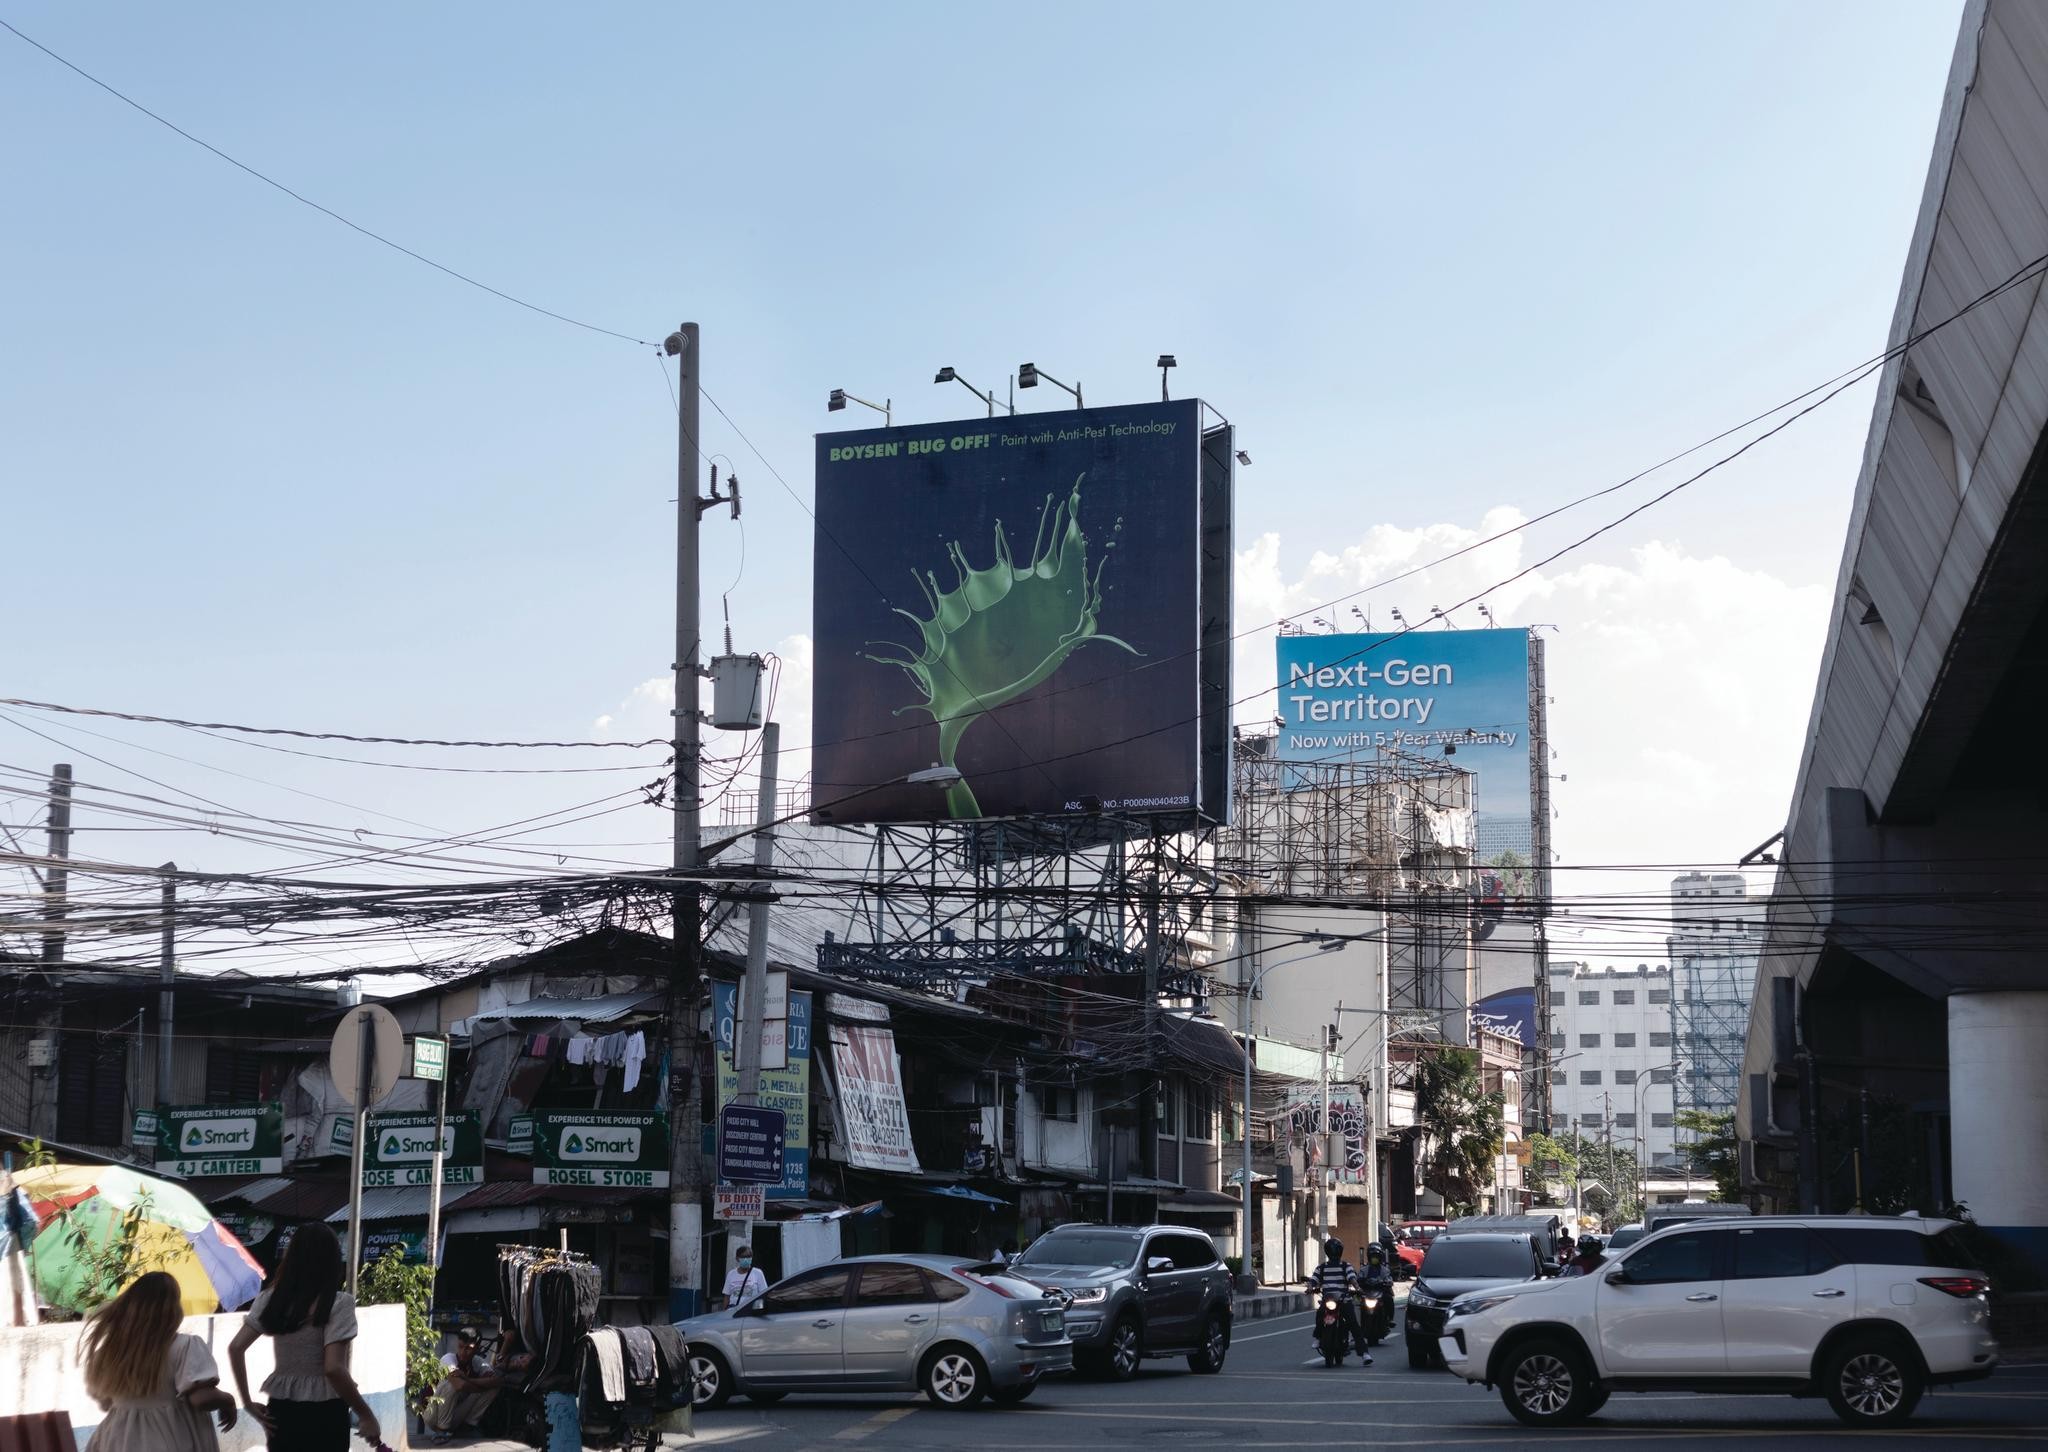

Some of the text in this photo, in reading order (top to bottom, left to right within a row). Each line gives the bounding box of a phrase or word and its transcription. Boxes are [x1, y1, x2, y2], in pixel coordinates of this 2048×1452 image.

[908, 439, 946, 455] BUG
[1001, 433, 1028, 446] Paint
[1030, 431, 1054, 444] with
[1057, 426, 1106, 441] Anti-Pest
[1109, 420, 1177, 437] Technology
[1290, 659, 1452, 688] Next-Gen
[1290, 693, 1434, 724] Territory
[1291, 730, 1517, 749] Now with 5-Year Warranty
[1471, 1013, 1523, 1040] Ford
[771, 1079, 799, 1093] METAL
[799, 1082, 805, 1093] &
[765, 1095, 803, 1109] CASKETS
[170, 1107, 268, 1119] EXPERIENCE THE POWER OF
[413, 1117, 427, 1125] THE
[428, 1115, 455, 1124] POER
[456, 1115, 467, 1123] OF
[548, 1115, 654, 1125] EXPERIENCE THE POWER OF
[740, 1117, 750, 1126] CITY
[205, 1128, 250, 1144] Smart
[402, 1137, 448, 1153] Smat
[585, 1137, 634, 1153] Smart
[738, 1145, 748, 1154] CITY
[176, 1160, 261, 1175] 4J CANTEEN
[785, 1162, 803, 1174] 1735
[407, 1168, 474, 1184] CANEEN
[549, 1169, 653, 1186] ROSEL STORE
[787, 1178, 805, 1191] Pasig
[718, 1194, 761, 1204] TB DOTS
